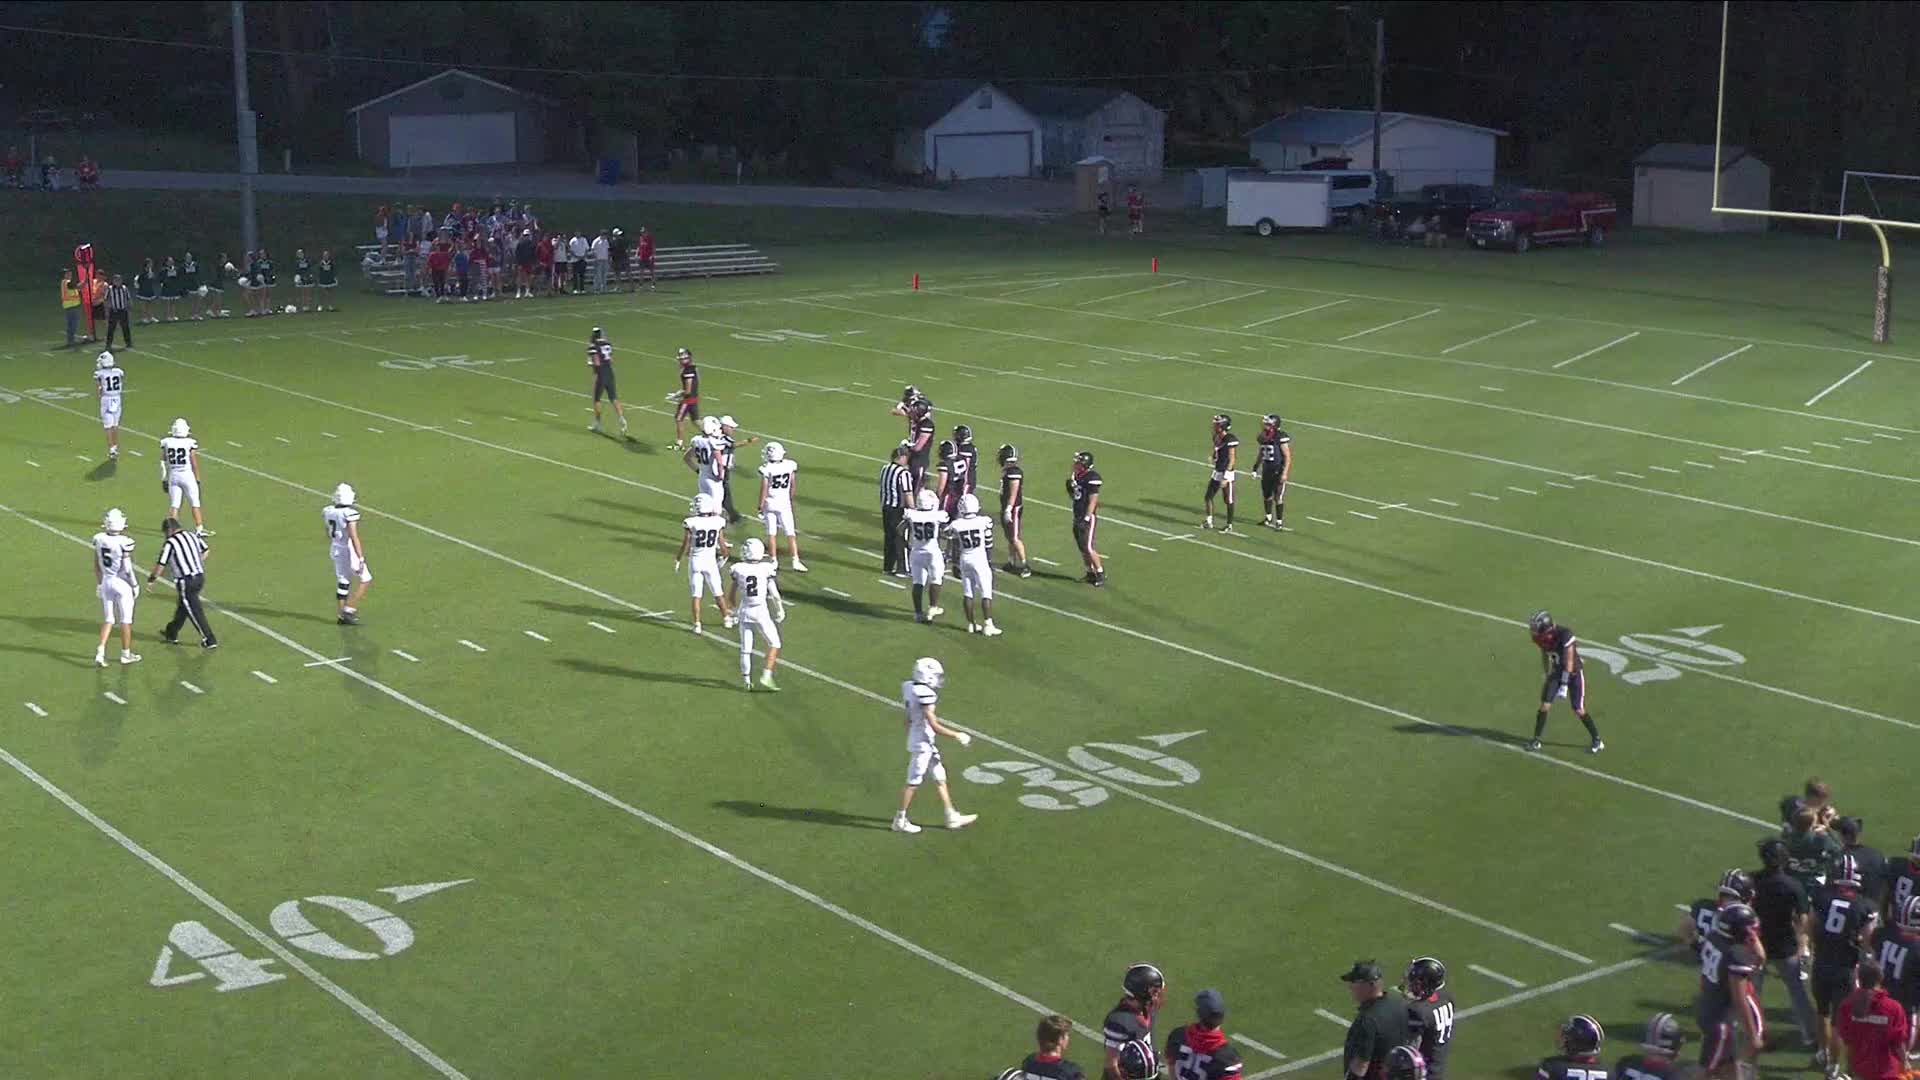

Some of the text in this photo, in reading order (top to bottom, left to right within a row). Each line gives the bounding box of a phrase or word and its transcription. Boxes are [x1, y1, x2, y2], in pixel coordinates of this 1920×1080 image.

[106, 376, 120, 391] 12
[167, 448, 186, 465] 22
[695, 529, 717, 547] 28
[101, 547, 112, 567] 5
[746, 576, 758, 597] 2
[962, 742, 1201, 810] 30
[1825, 899, 1851, 933] 6
[150, 896, 415, 992] 40
[1880, 940, 1908, 979] 14
[1433, 1002, 1453, 1043] 44
[1175, 1045, 1213, 1080] 25
